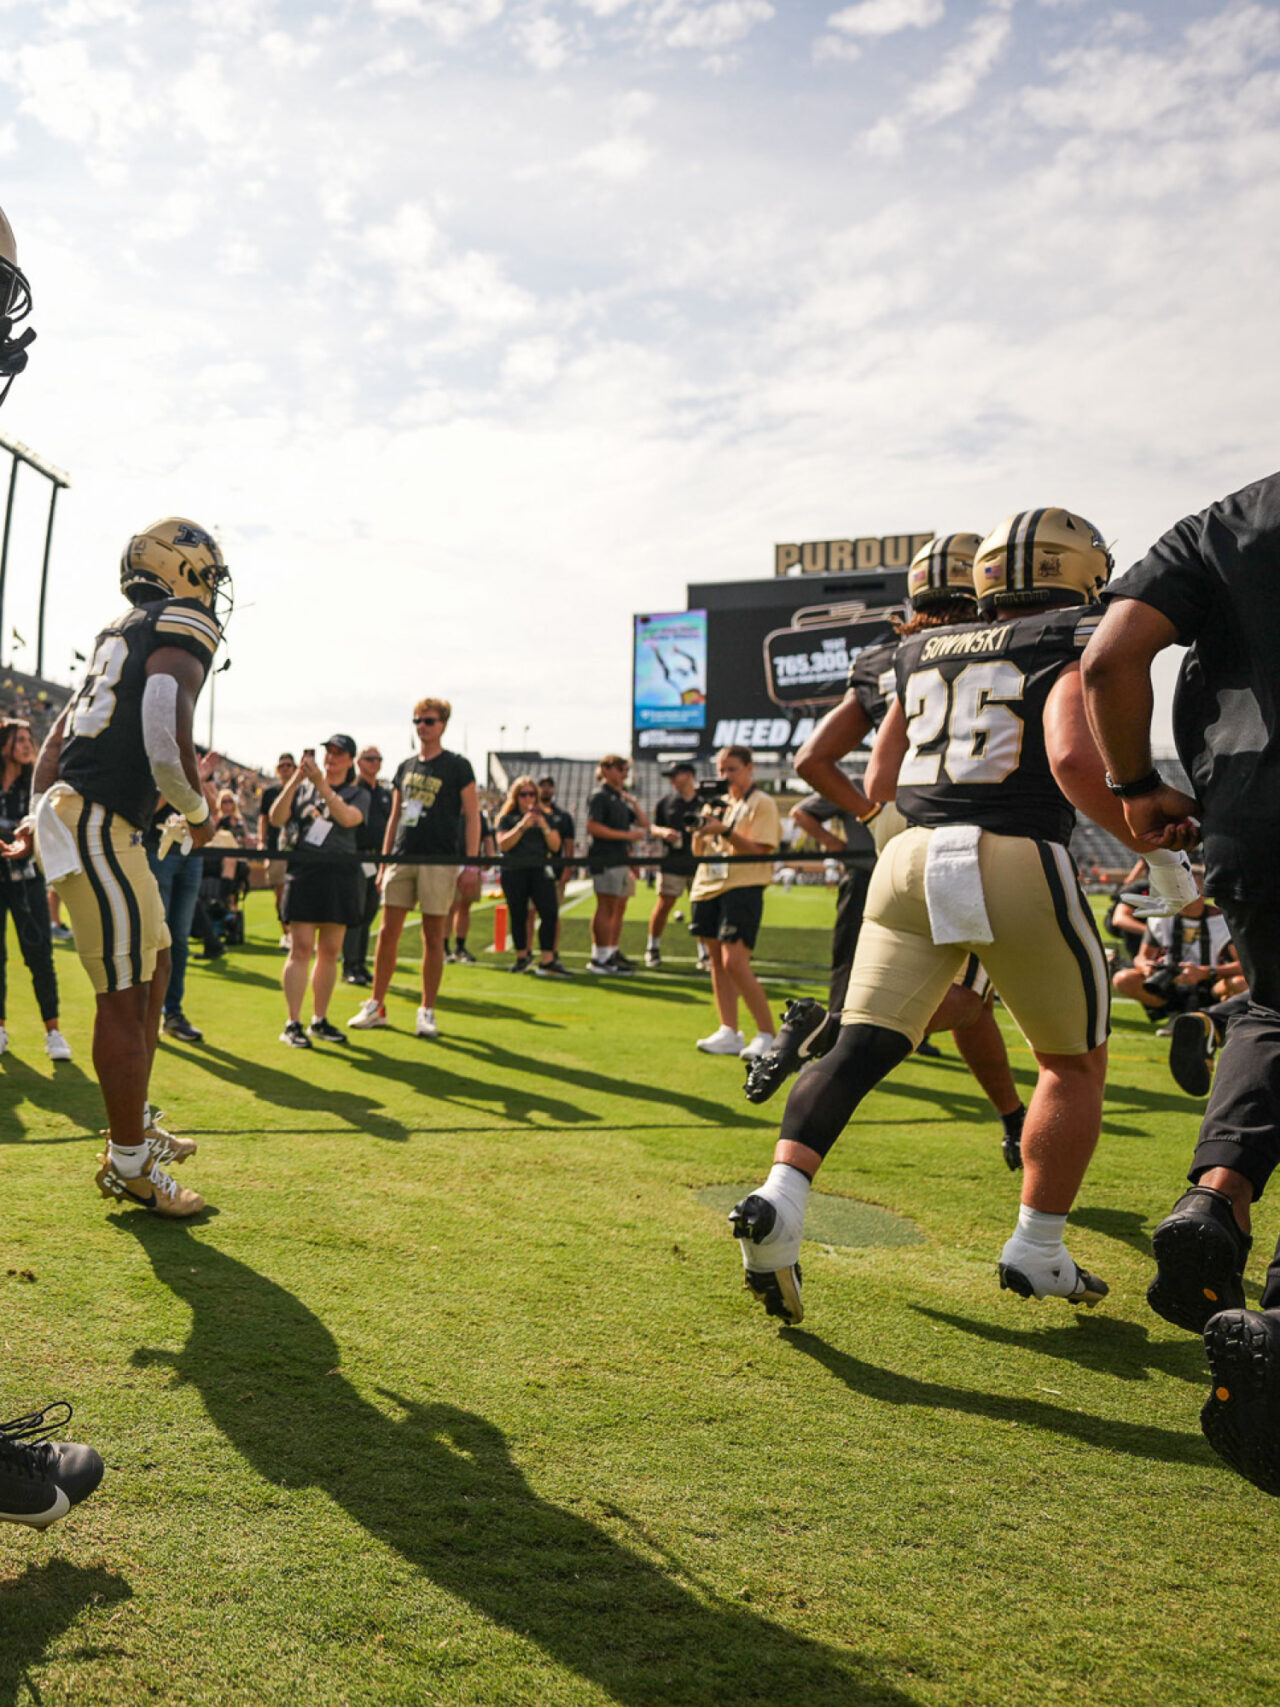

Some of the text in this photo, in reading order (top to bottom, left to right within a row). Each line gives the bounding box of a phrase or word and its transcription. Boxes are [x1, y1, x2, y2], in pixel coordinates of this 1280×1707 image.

[921, 625, 1011, 661] SOWINSKI
[712, 718, 791, 748] NEED
[897, 660, 1026, 787] 26
